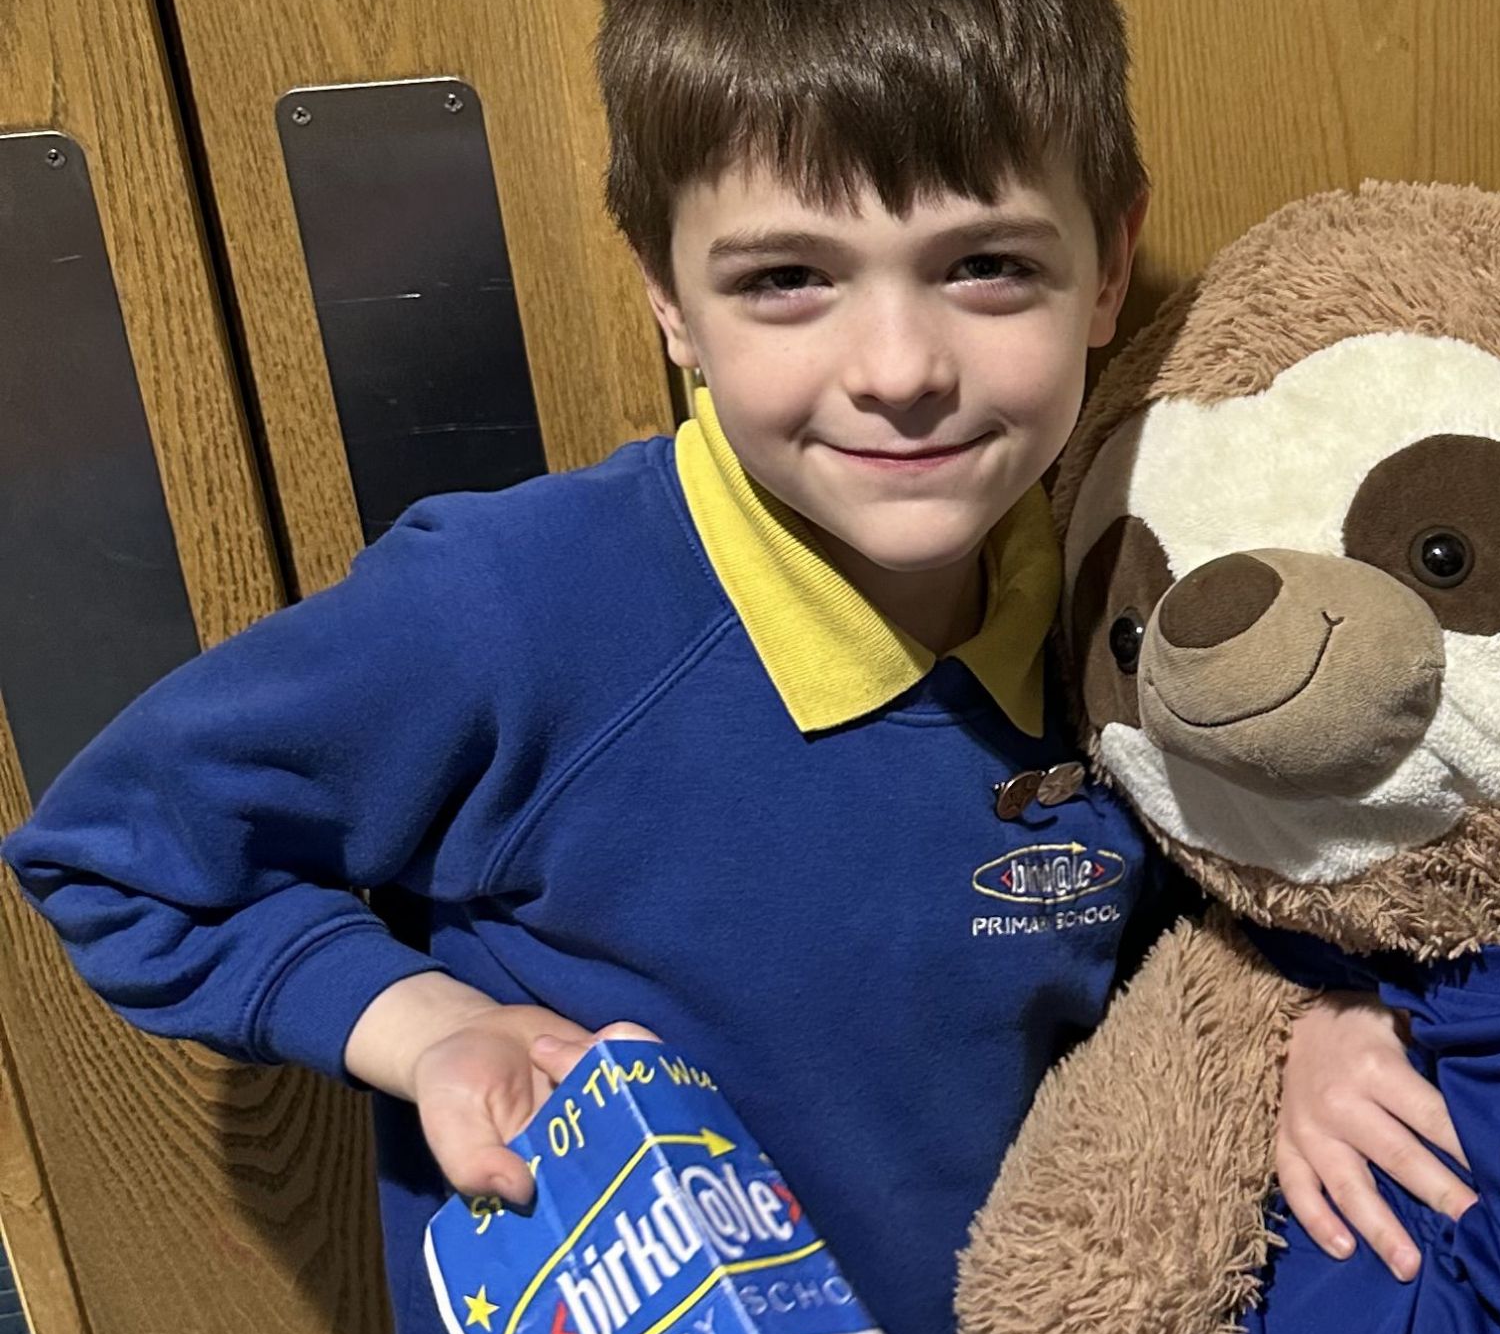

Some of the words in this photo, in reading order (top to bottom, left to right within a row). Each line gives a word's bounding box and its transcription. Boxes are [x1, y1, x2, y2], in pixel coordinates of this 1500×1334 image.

[1056, 905, 1120, 929] SCHOOL
[548, 1099, 585, 1157] Of
[582, 1058, 655, 1108] The
[738, 1276, 851, 1316] SCHO
